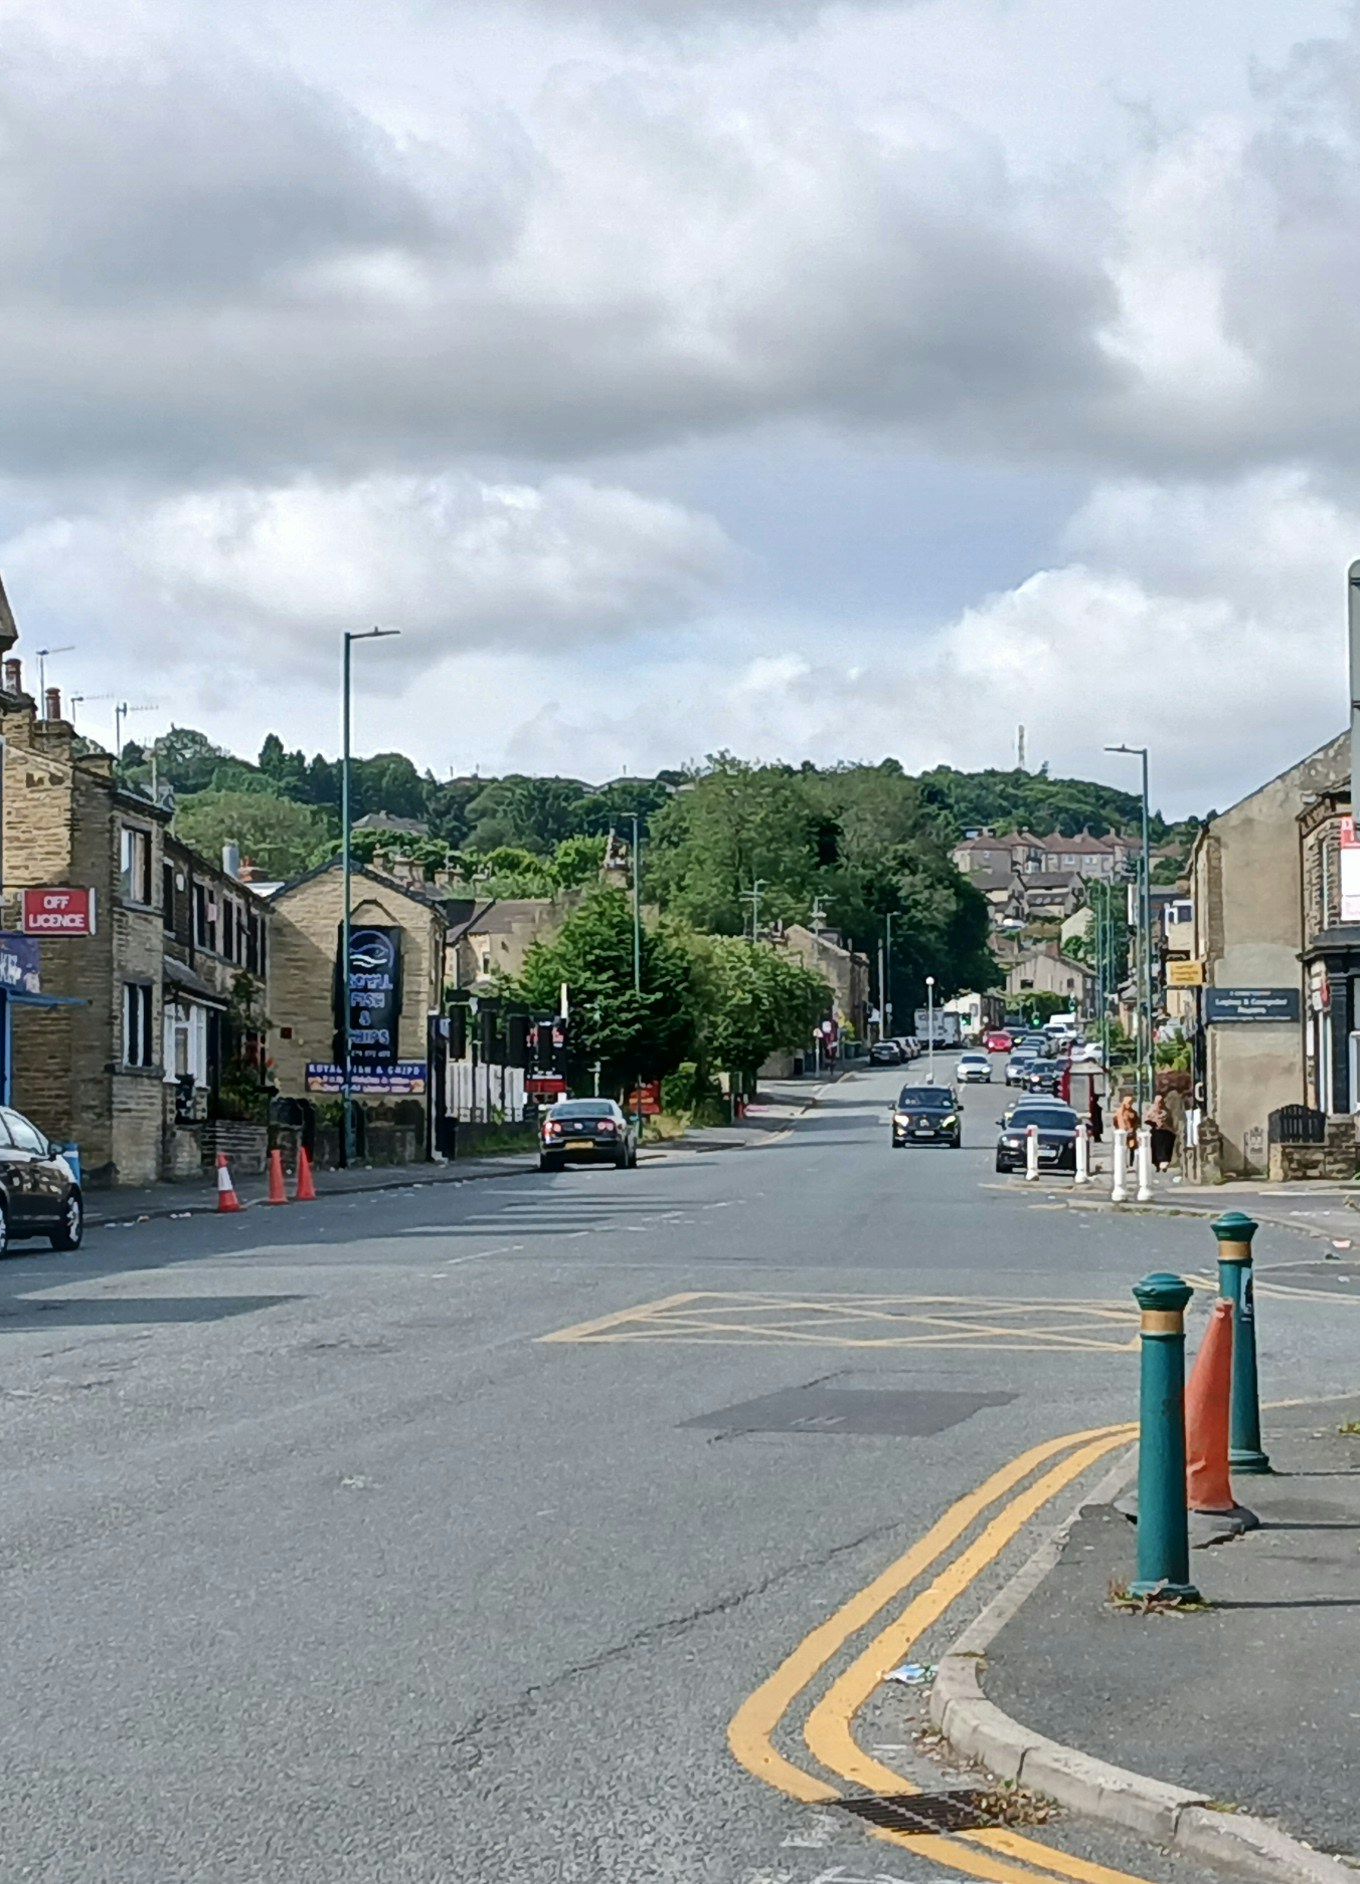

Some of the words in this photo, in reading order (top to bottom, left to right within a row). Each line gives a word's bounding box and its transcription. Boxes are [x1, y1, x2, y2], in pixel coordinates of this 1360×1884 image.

[43, 895, 70, 910] OFF
[28, 914, 85, 928] LICENCE
[351, 992, 385, 1008] FISH
[358, 1009, 371, 1026] &
